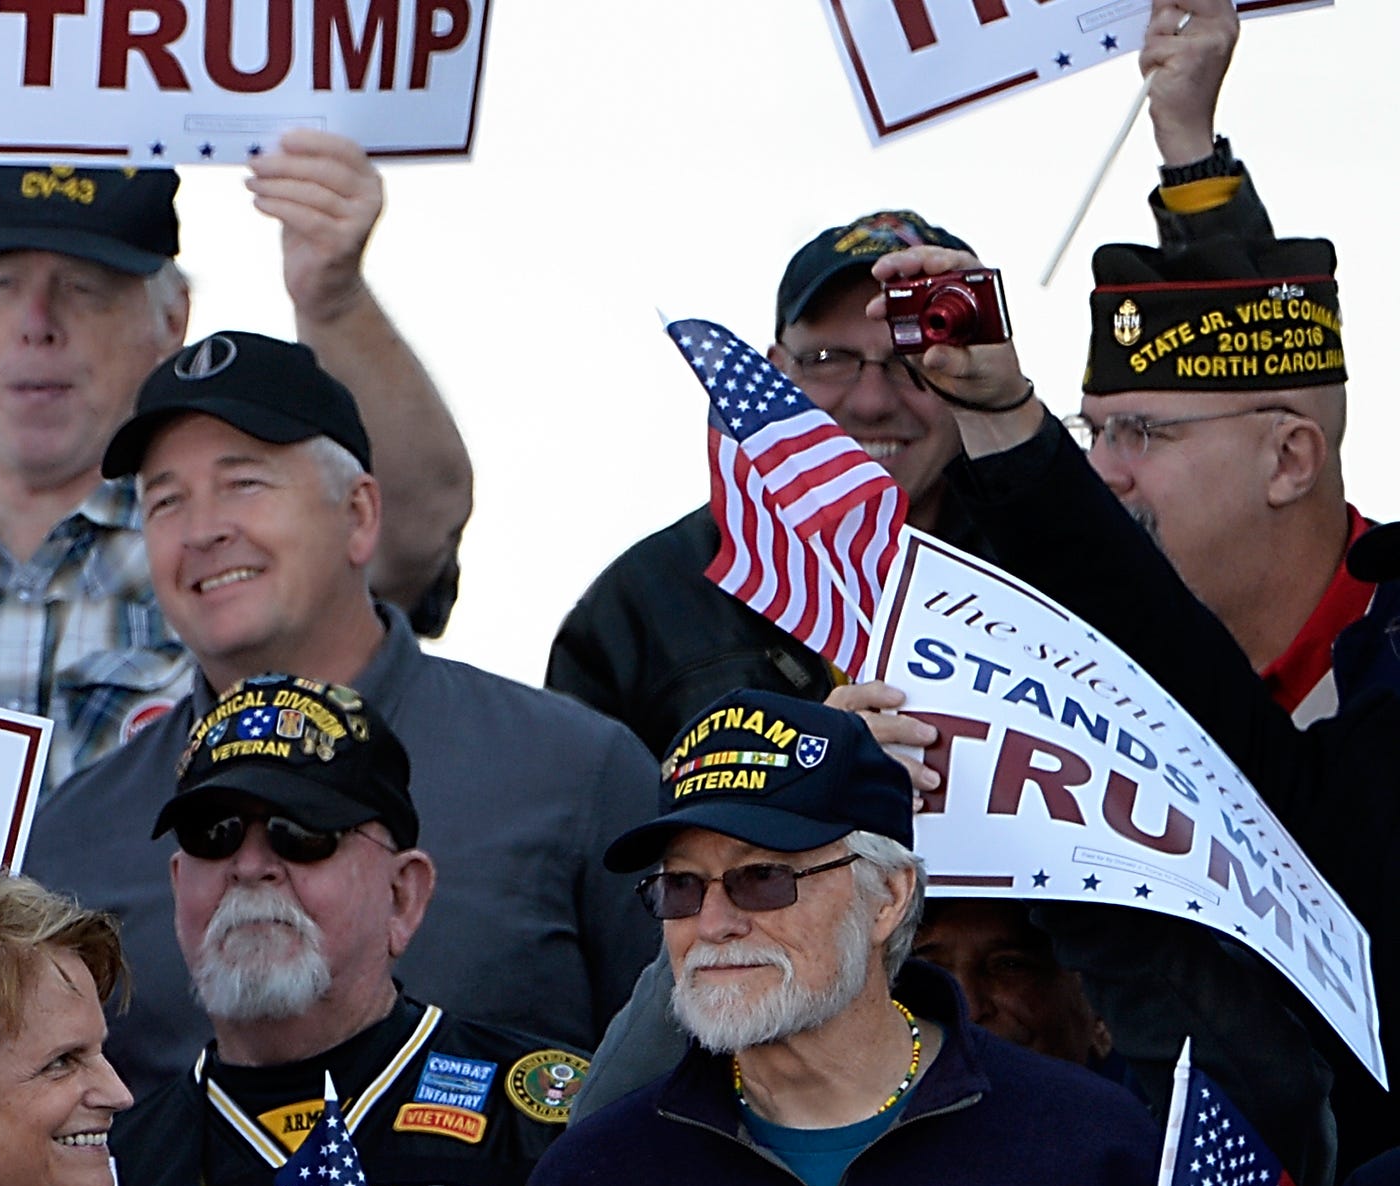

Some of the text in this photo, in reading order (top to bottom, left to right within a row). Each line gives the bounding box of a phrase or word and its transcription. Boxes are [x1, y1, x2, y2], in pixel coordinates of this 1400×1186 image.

[1130, 321, 1196, 374] STATE
[1200, 310, 1234, 336] JR.
[1235, 299, 1284, 325] VICE
[1218, 326, 1325, 353] 2015-2016
[1176, 355, 1257, 377] NORTH
[923, 589, 1018, 643] the
[1023, 640, 1168, 733] silent
[675, 707, 798, 758] VIETNAM
[906, 637, 1200, 806] STANDS
[211, 740, 290, 763] VETERAN
[674, 770, 767, 799] VETERAN
[428, 1056, 493, 1079] COMBAT
[417, 1089, 482, 1108] INFANTRY
[405, 1110, 476, 1138] VIETNAM
